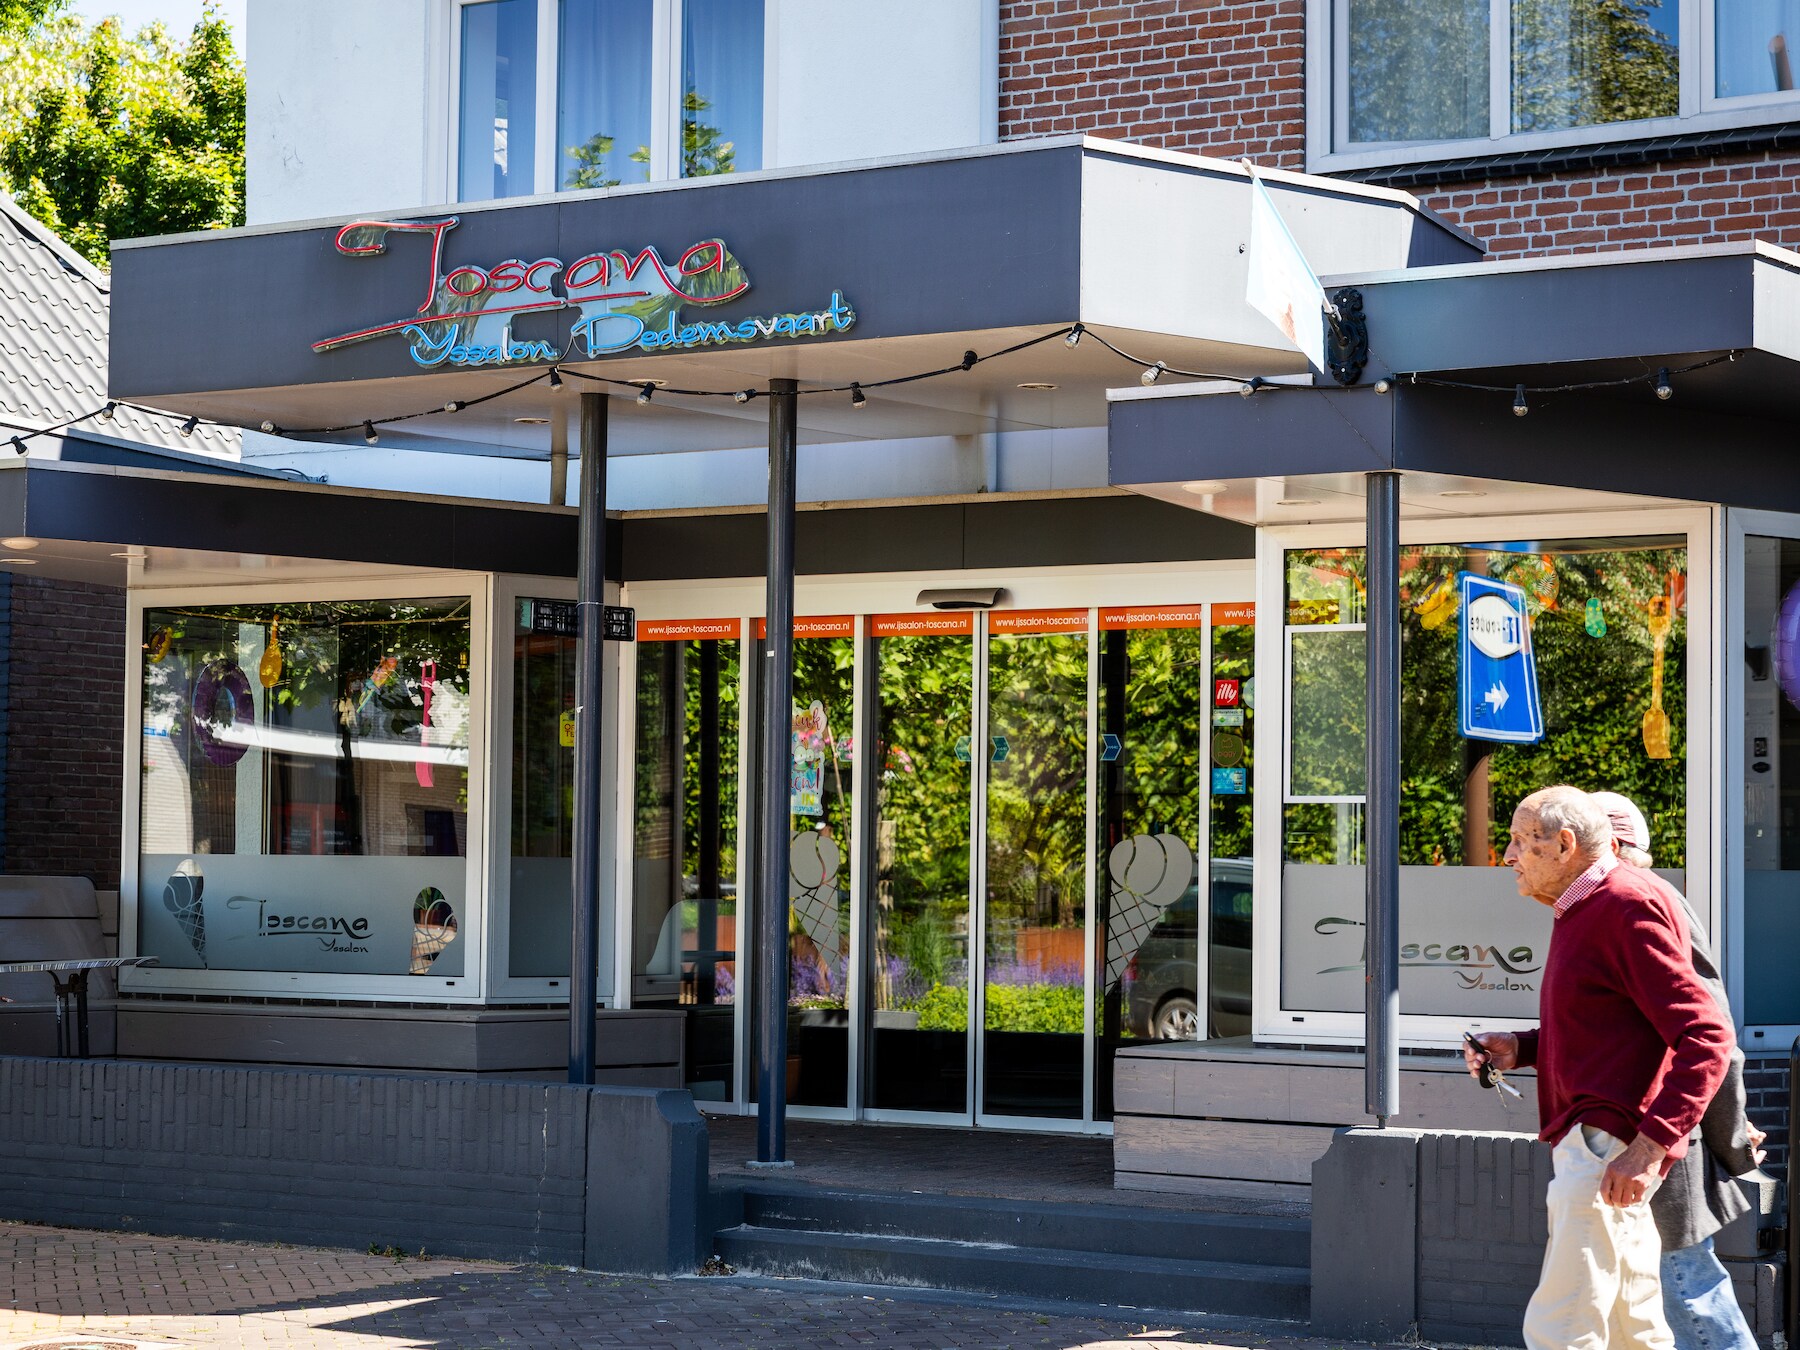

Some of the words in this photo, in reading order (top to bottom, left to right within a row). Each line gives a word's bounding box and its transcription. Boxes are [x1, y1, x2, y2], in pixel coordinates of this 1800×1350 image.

[332, 217, 750, 314] Toscana
[402, 322, 556, 365] Yssalon
[571, 291, 850, 355] Dedemsvaart
[877, 619, 967, 631] www.ijssalon-toscana.nl
[1105, 611, 1200, 624] www.ijssalon-toscana.n
[648, 623, 731, 635] www.ijssalon-toscana.nl
[1217, 683, 1237, 703] illy
[226, 895, 374, 940] Toscana
[315, 936, 369, 953] Yssalon
[1314, 917, 1542, 975] Tscana
[1453, 970, 1535, 991] Yssalon
